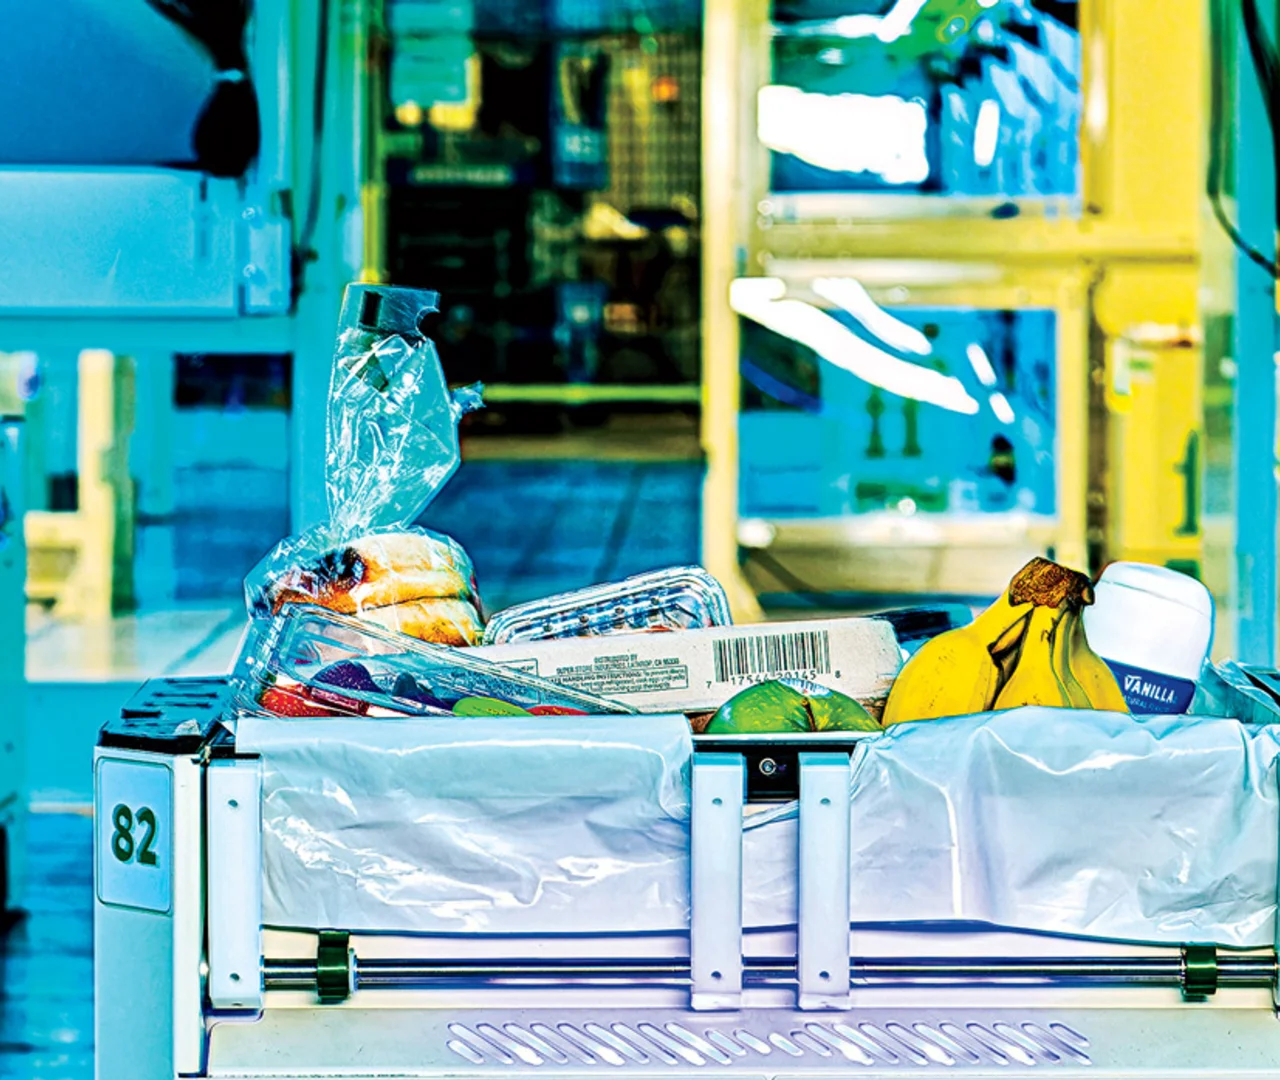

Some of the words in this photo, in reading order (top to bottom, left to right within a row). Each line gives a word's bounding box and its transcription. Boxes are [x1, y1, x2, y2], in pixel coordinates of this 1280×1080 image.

[706, 681, 713, 689] 7
[1124, 674, 1175, 704] VANILLA
[111, 803, 159, 868] 82
